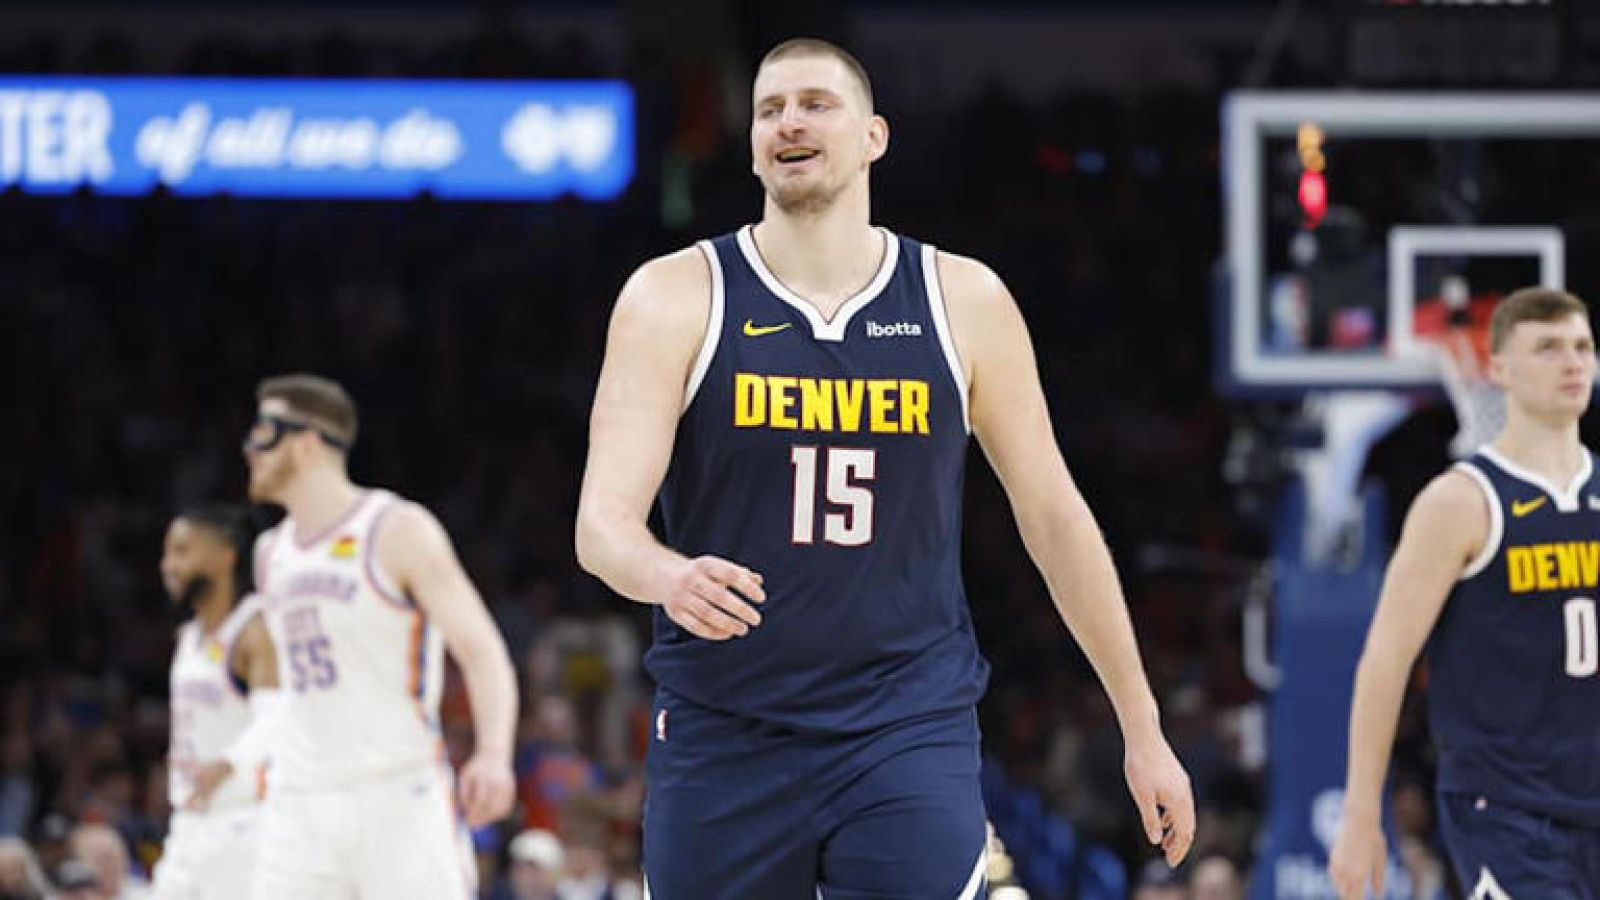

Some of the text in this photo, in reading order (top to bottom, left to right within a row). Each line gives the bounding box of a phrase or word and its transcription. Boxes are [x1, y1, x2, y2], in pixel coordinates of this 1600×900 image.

[0, 88, 114, 184] TER
[866, 320, 922, 338] ibotta
[734, 371, 931, 436] DENVER
[790, 444, 877, 547] 15
[1506, 540, 1600, 594] DENV
[287, 634, 338, 692] 55
[1563, 597, 1600, 679] 0
